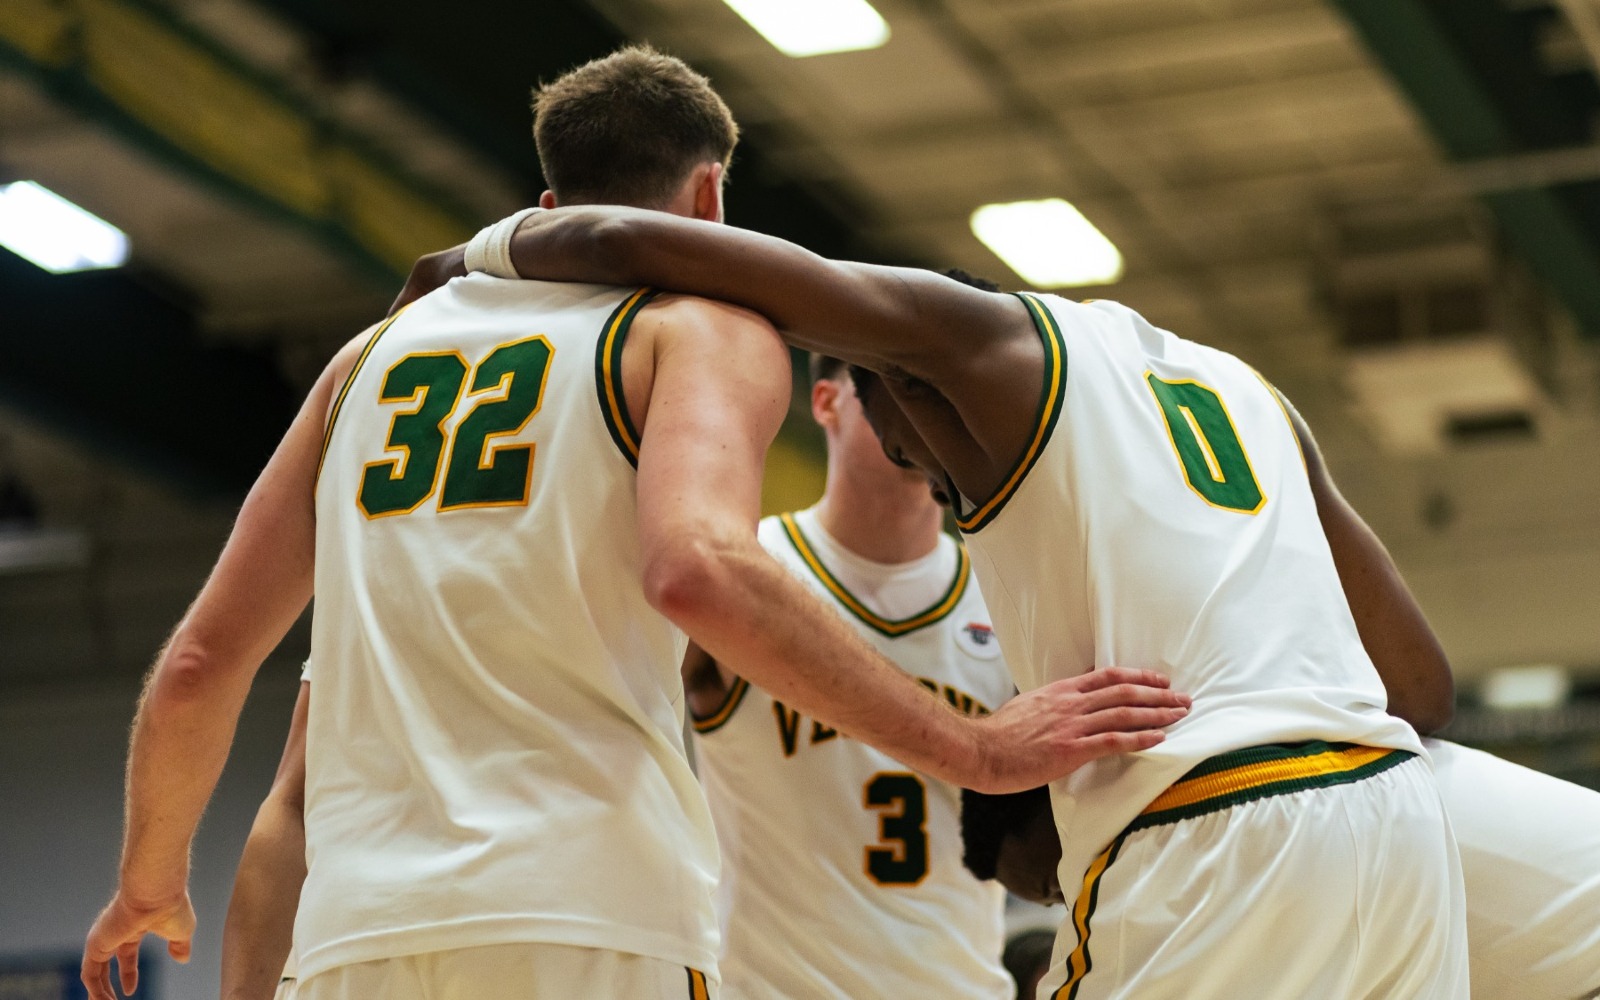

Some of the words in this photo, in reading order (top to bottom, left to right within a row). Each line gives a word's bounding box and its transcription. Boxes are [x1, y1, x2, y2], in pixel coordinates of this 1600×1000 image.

[355, 334, 556, 521] 32
[1143, 369, 1268, 516] 0
[862, 770, 930, 887] 3
